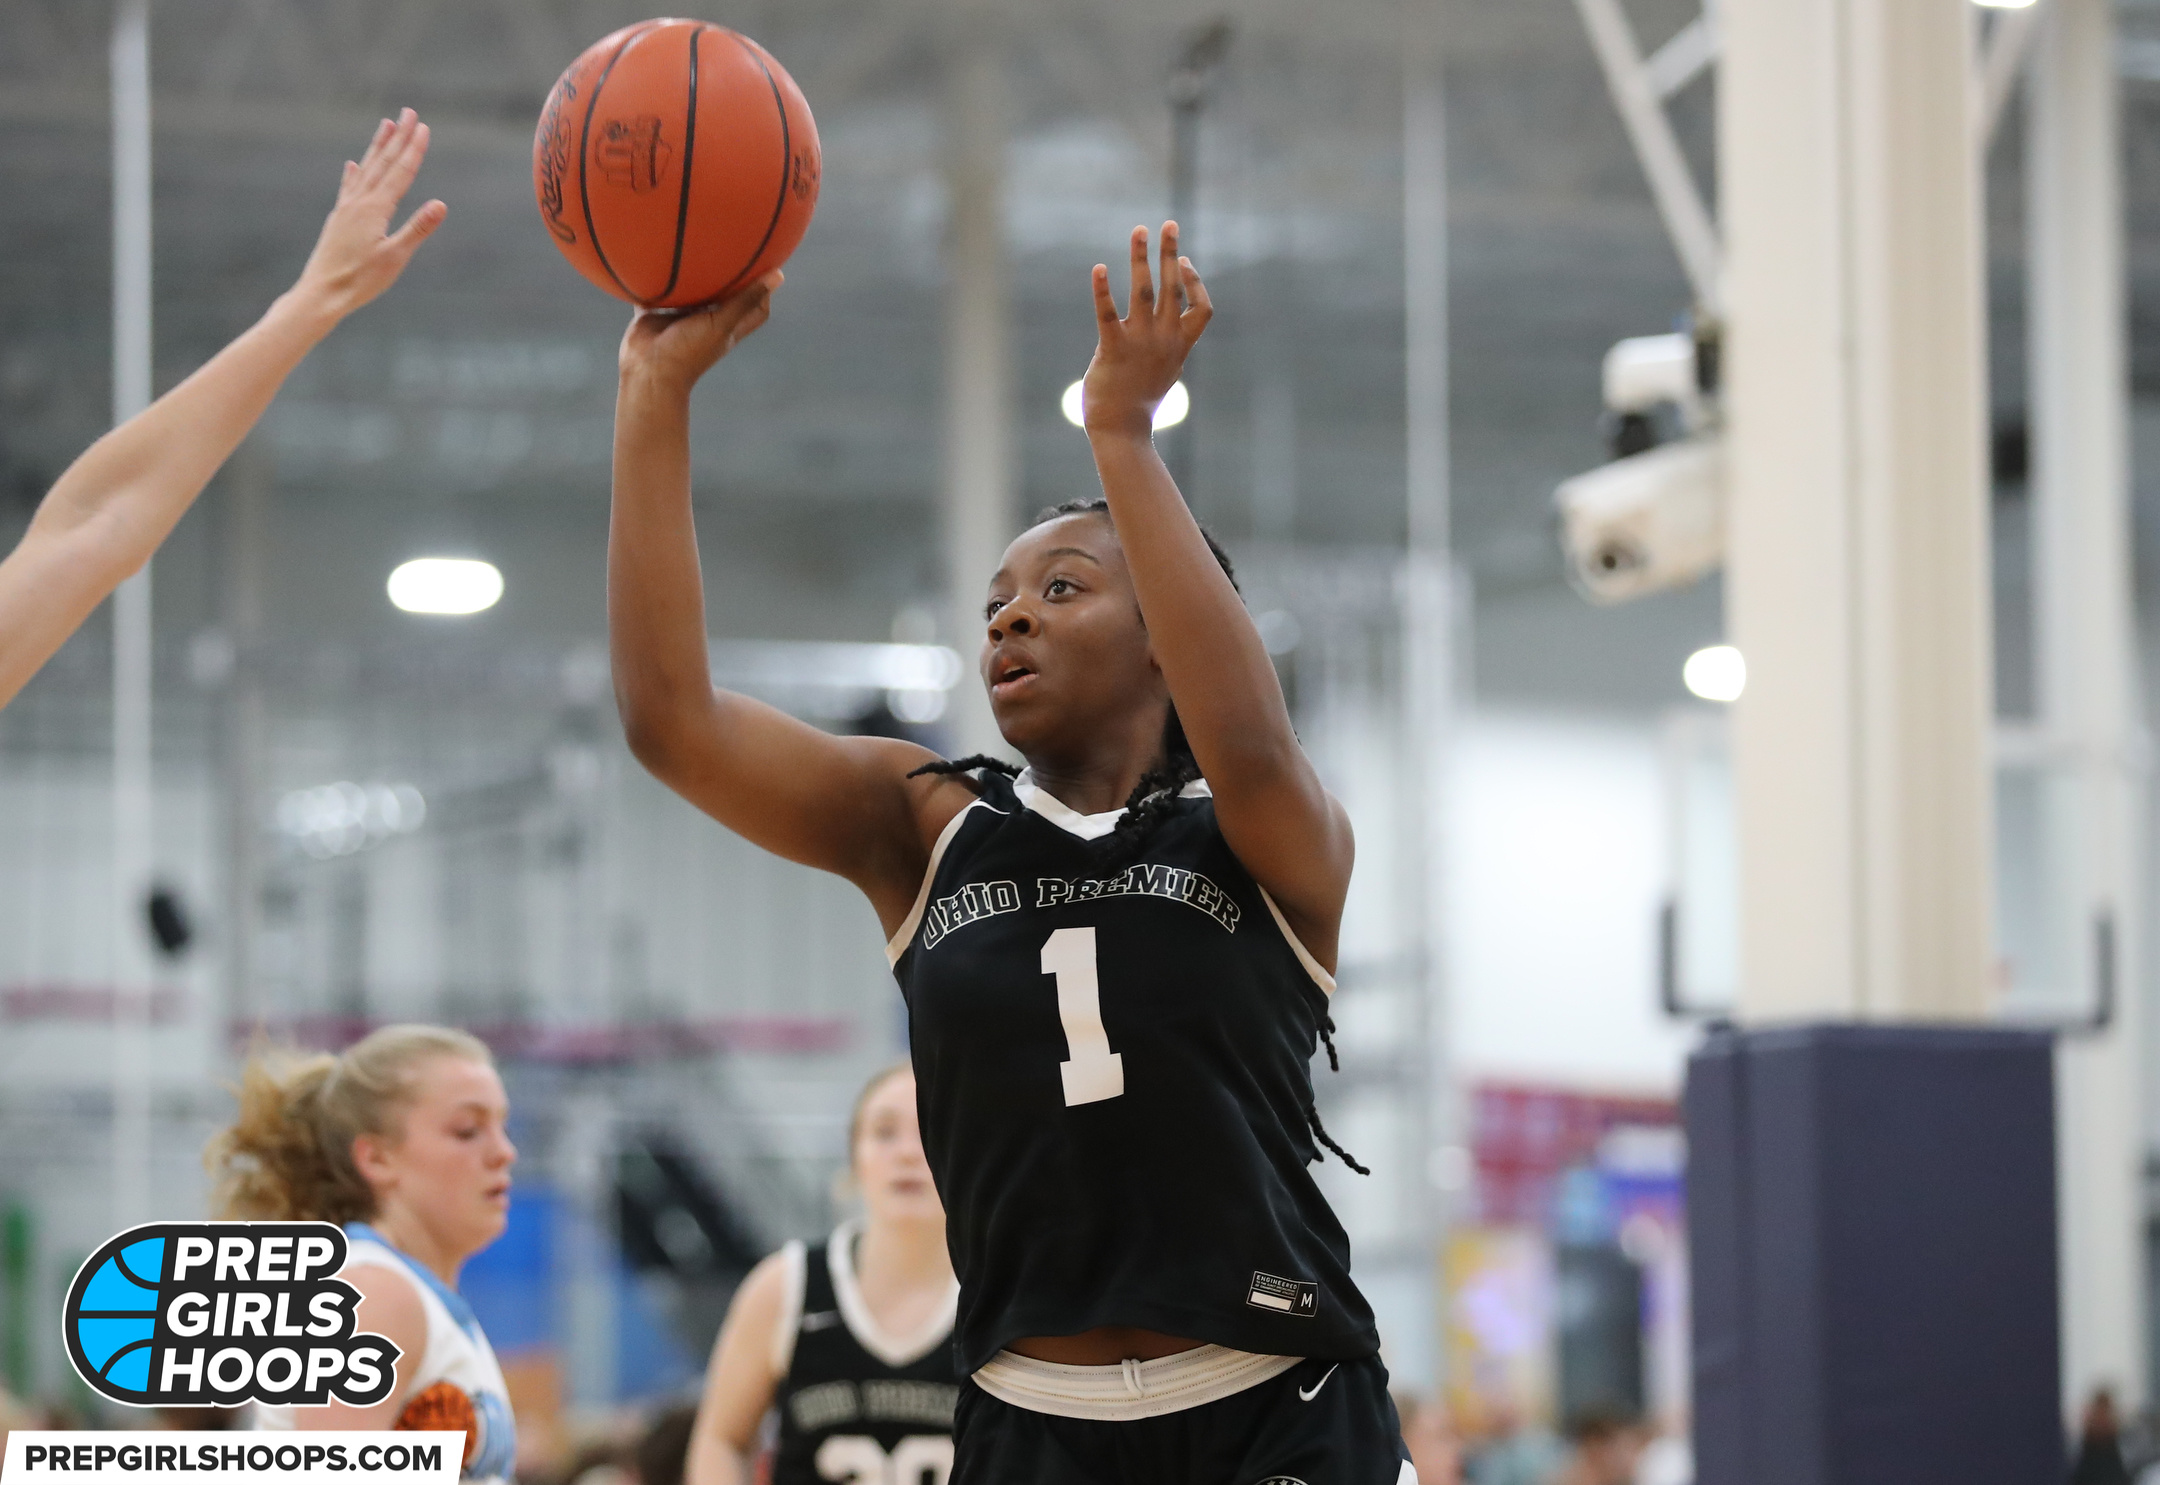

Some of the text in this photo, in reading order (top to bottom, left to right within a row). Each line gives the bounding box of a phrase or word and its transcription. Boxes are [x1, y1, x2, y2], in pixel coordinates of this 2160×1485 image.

[922, 863, 1242, 950] OHIO PREMIER
[1040, 926, 1125, 1107] 1
[1256, 1275, 1298, 1290] ENGINEERED
[1301, 1293, 1313, 1308] M
